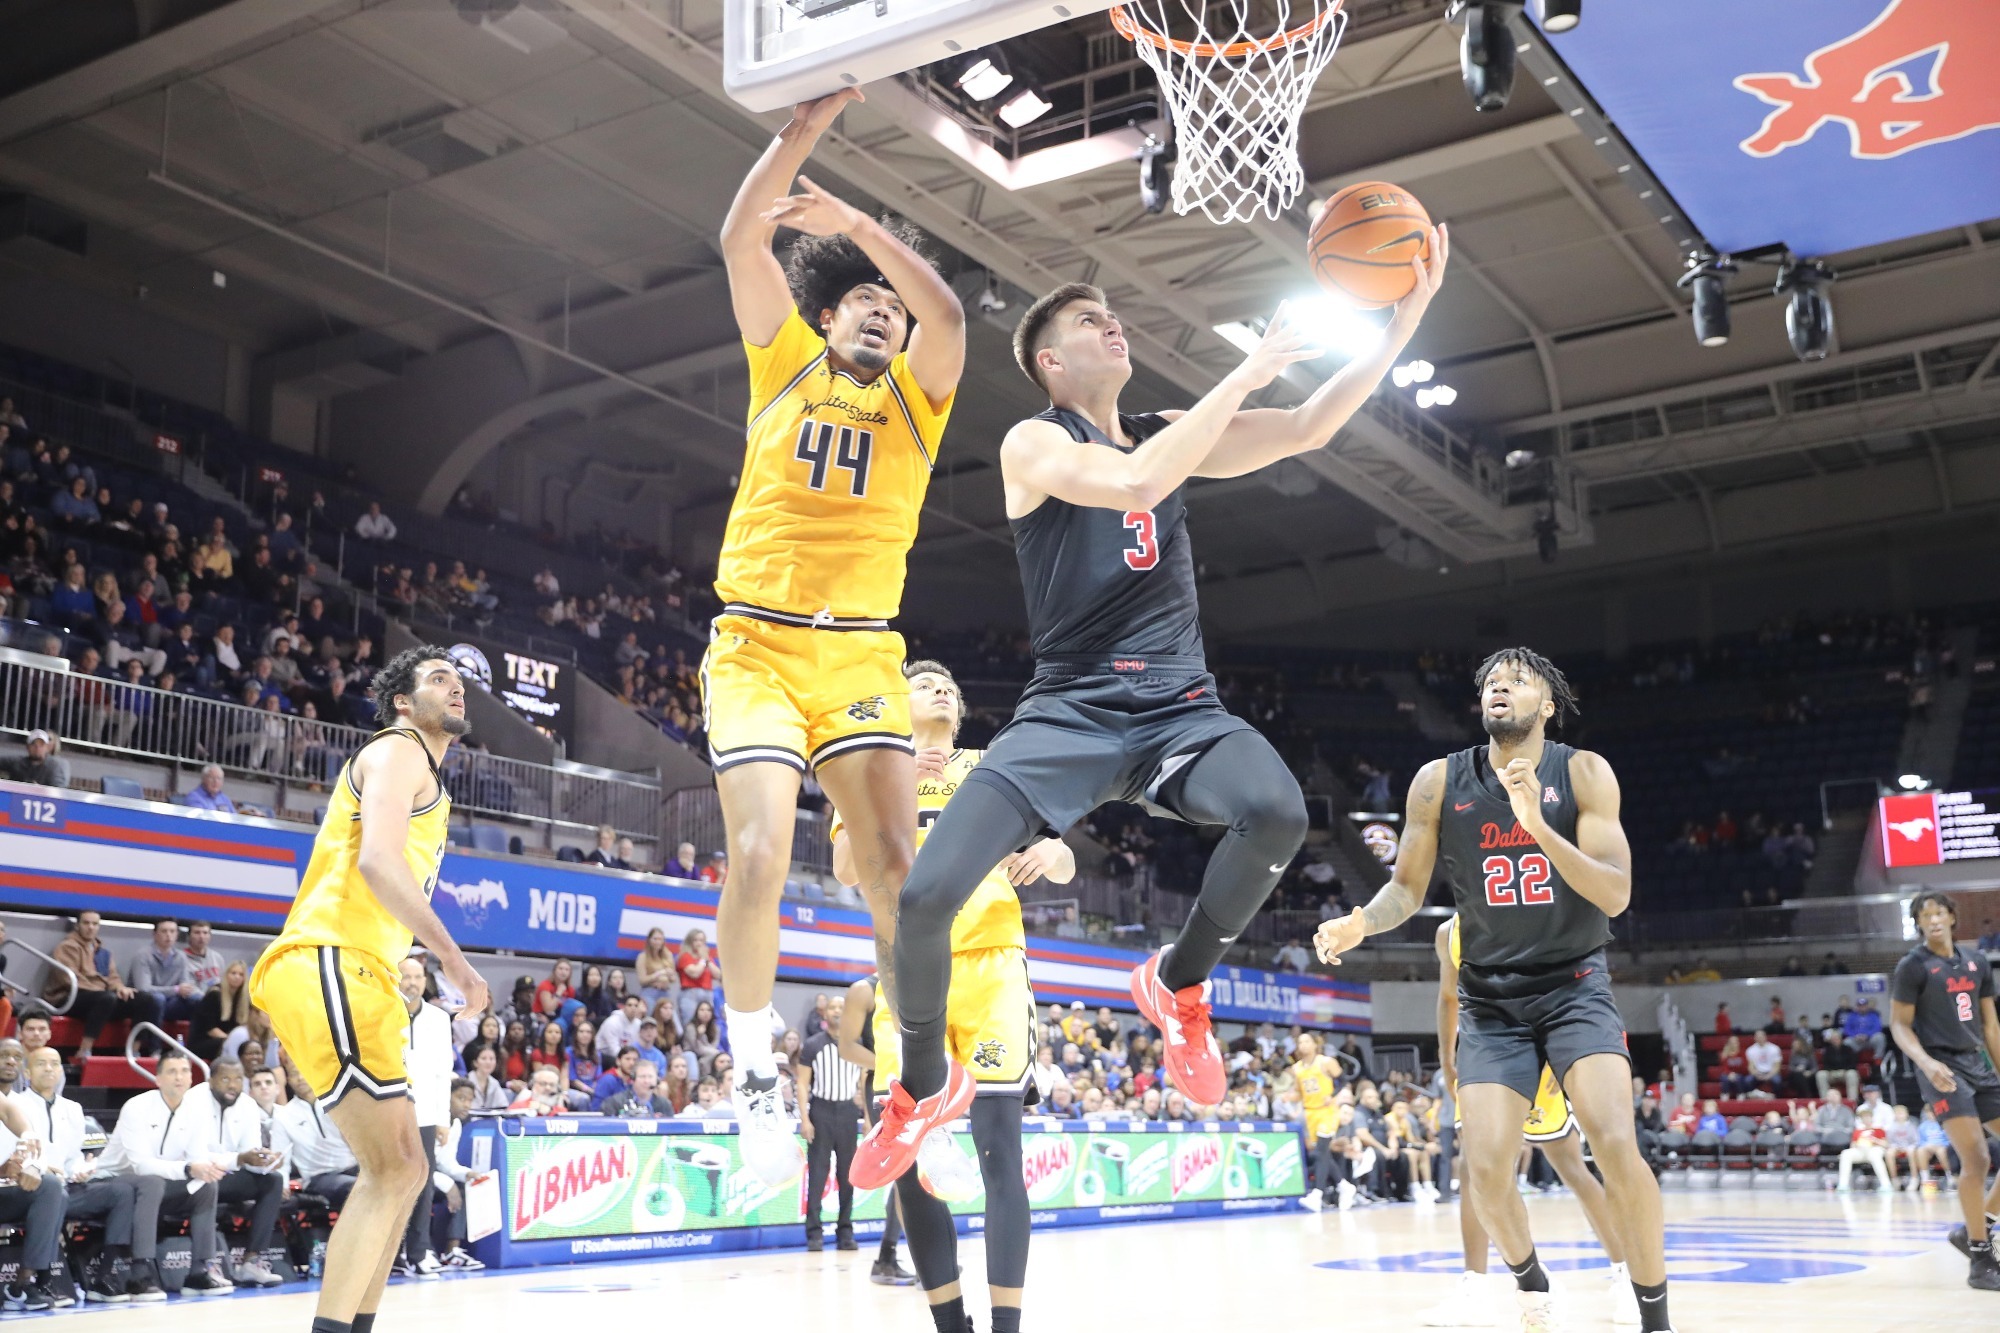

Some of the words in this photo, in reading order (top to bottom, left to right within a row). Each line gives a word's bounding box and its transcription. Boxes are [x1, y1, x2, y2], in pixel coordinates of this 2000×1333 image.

[847, 405, 889, 426] State
[794, 418, 873, 499] 44
[1123, 511, 1159, 571] 3
[503, 652, 560, 690] TEXT
[1113, 660, 1146, 671] SMU
[22, 799, 57, 824] 112
[1479, 820, 1538, 848] Dalla
[1481, 853, 1554, 906] 22
[528, 887, 597, 936] MOB
[796, 906, 815, 924] 112
[1956, 992, 1973, 1021] 2
[545, 1119, 579, 1134] UTSW
[1024, 1140, 1070, 1191] BMAN
